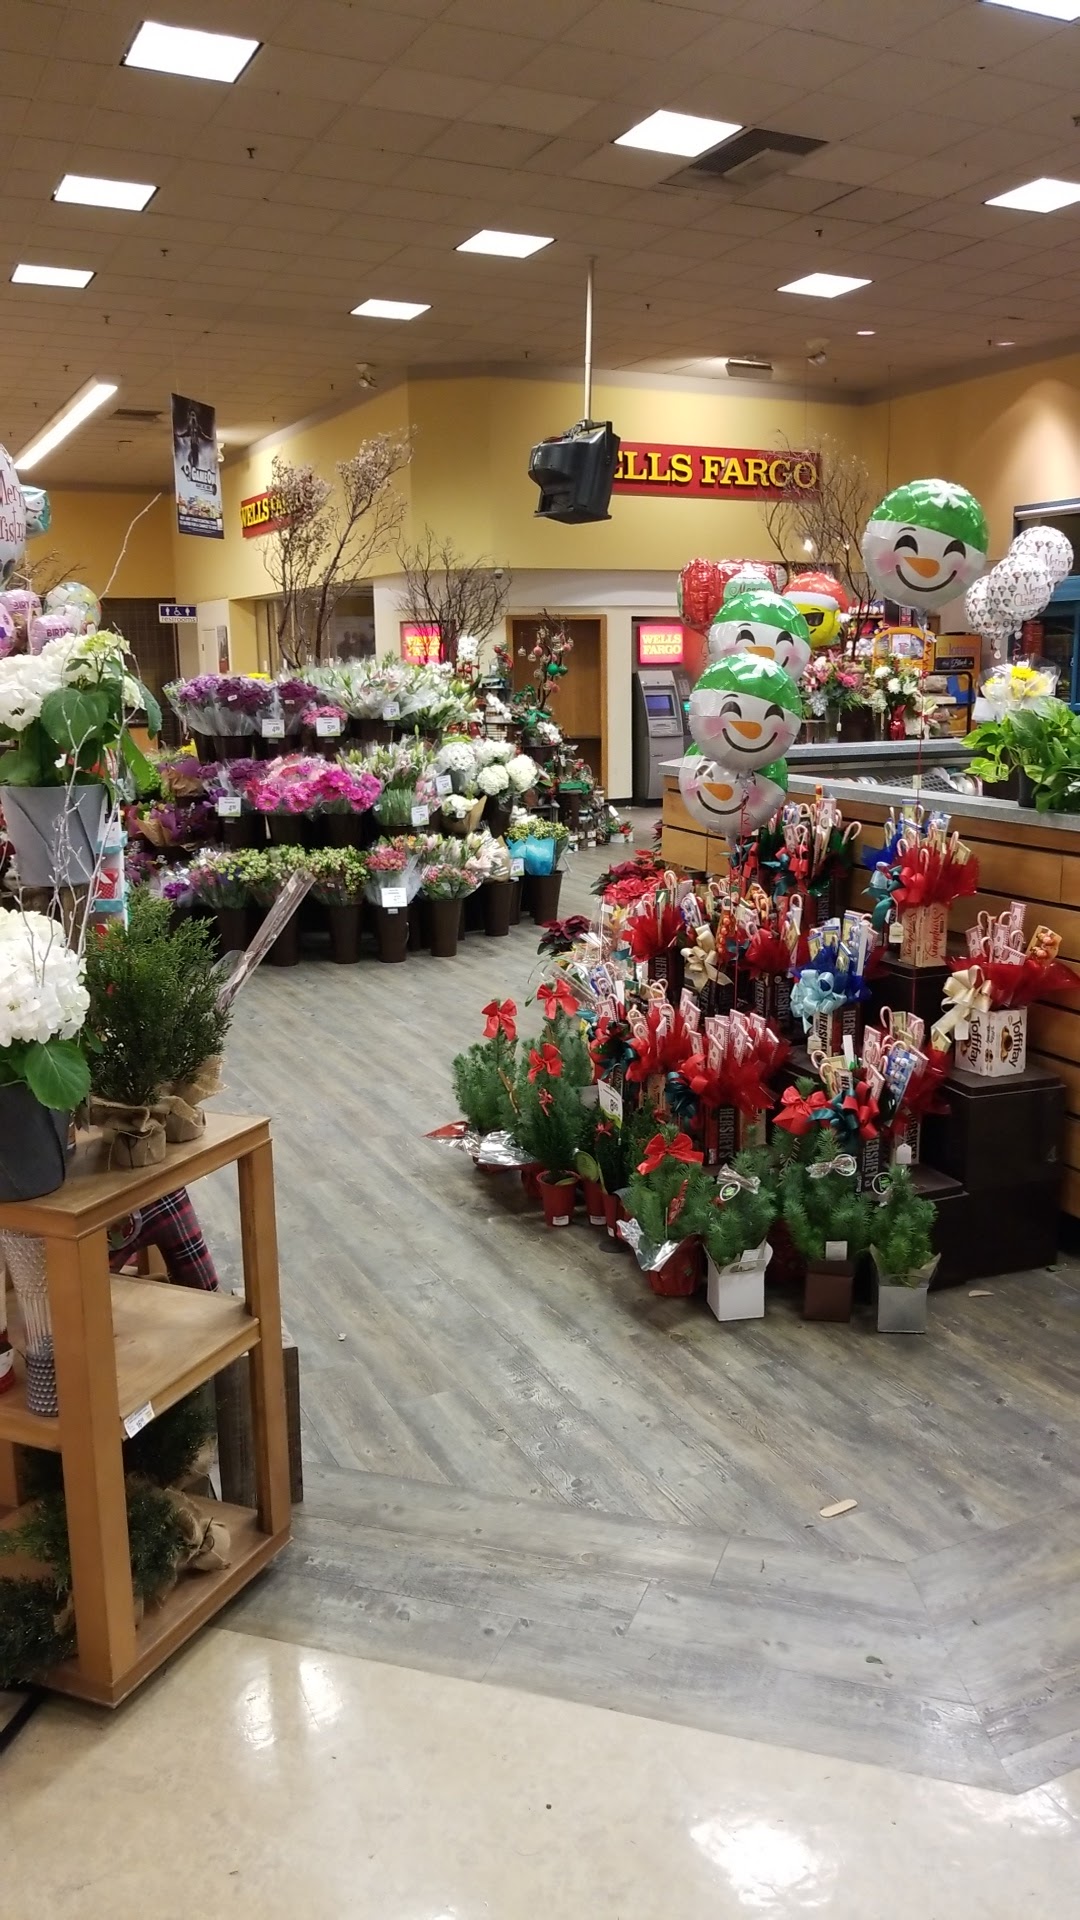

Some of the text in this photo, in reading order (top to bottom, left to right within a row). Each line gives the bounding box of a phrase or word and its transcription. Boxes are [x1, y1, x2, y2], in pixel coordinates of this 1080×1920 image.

[614, 451, 817, 489] LLS FARGO
[241, 498, 269, 527] WELLS
[643, 634, 682, 644] WELLS
[643, 644, 681, 655] FARGO
[926, 913, 945, 958] Symphony
[968, 1016, 982, 1067] Toffifay
[1009, 1016, 1024, 1068] Toffifay
[719, 1108, 734, 1158] HERSHEY'S
